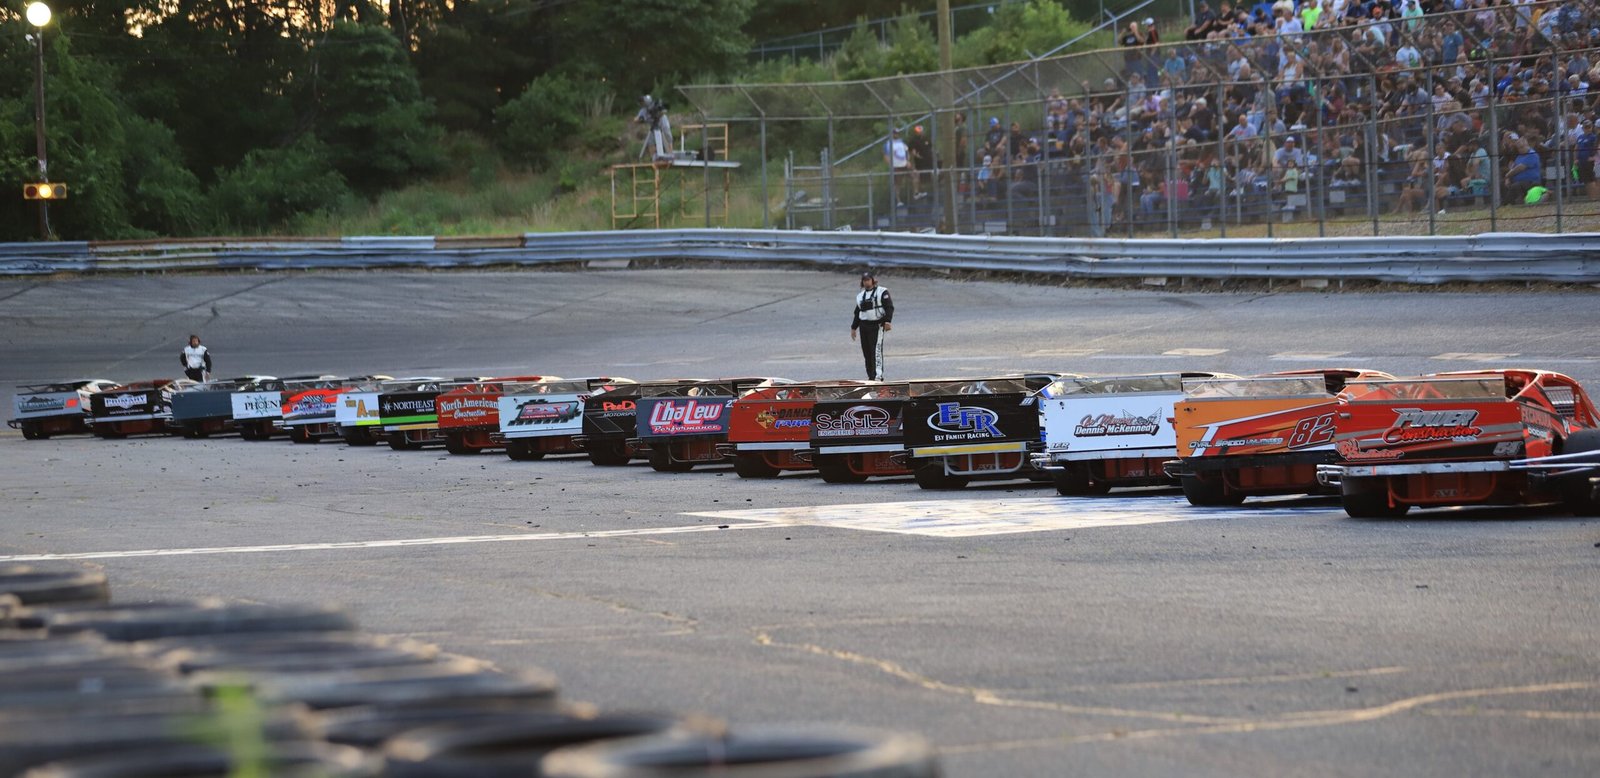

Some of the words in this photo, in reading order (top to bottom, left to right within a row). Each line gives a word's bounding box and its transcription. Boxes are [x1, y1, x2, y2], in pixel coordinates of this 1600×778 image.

[393, 400, 434, 410] NORTHEAST
[441, 400, 462, 412] North
[463, 398, 499, 410] American
[651, 401, 721, 426] ChaLew
[817, 412, 889, 429] Schultz
[937, 402, 1006, 437] EFR
[1392, 408, 1479, 428] POWER
[654, 425, 719, 433] Performance
[818, 429, 854, 437] ENGINEERED
[1075, 425, 1105, 435] Dennis
[1106, 423, 1157, 434] McKennedy
[1288, 412, 1337, 449] 82
[1382, 426, 1483, 445] Construction
[945, 433, 966, 441] FAMILY
[967, 432, 990, 440] RACING
[1189, 440, 1212, 448] OVAL
[1214, 440, 1246, 448] SPEED
